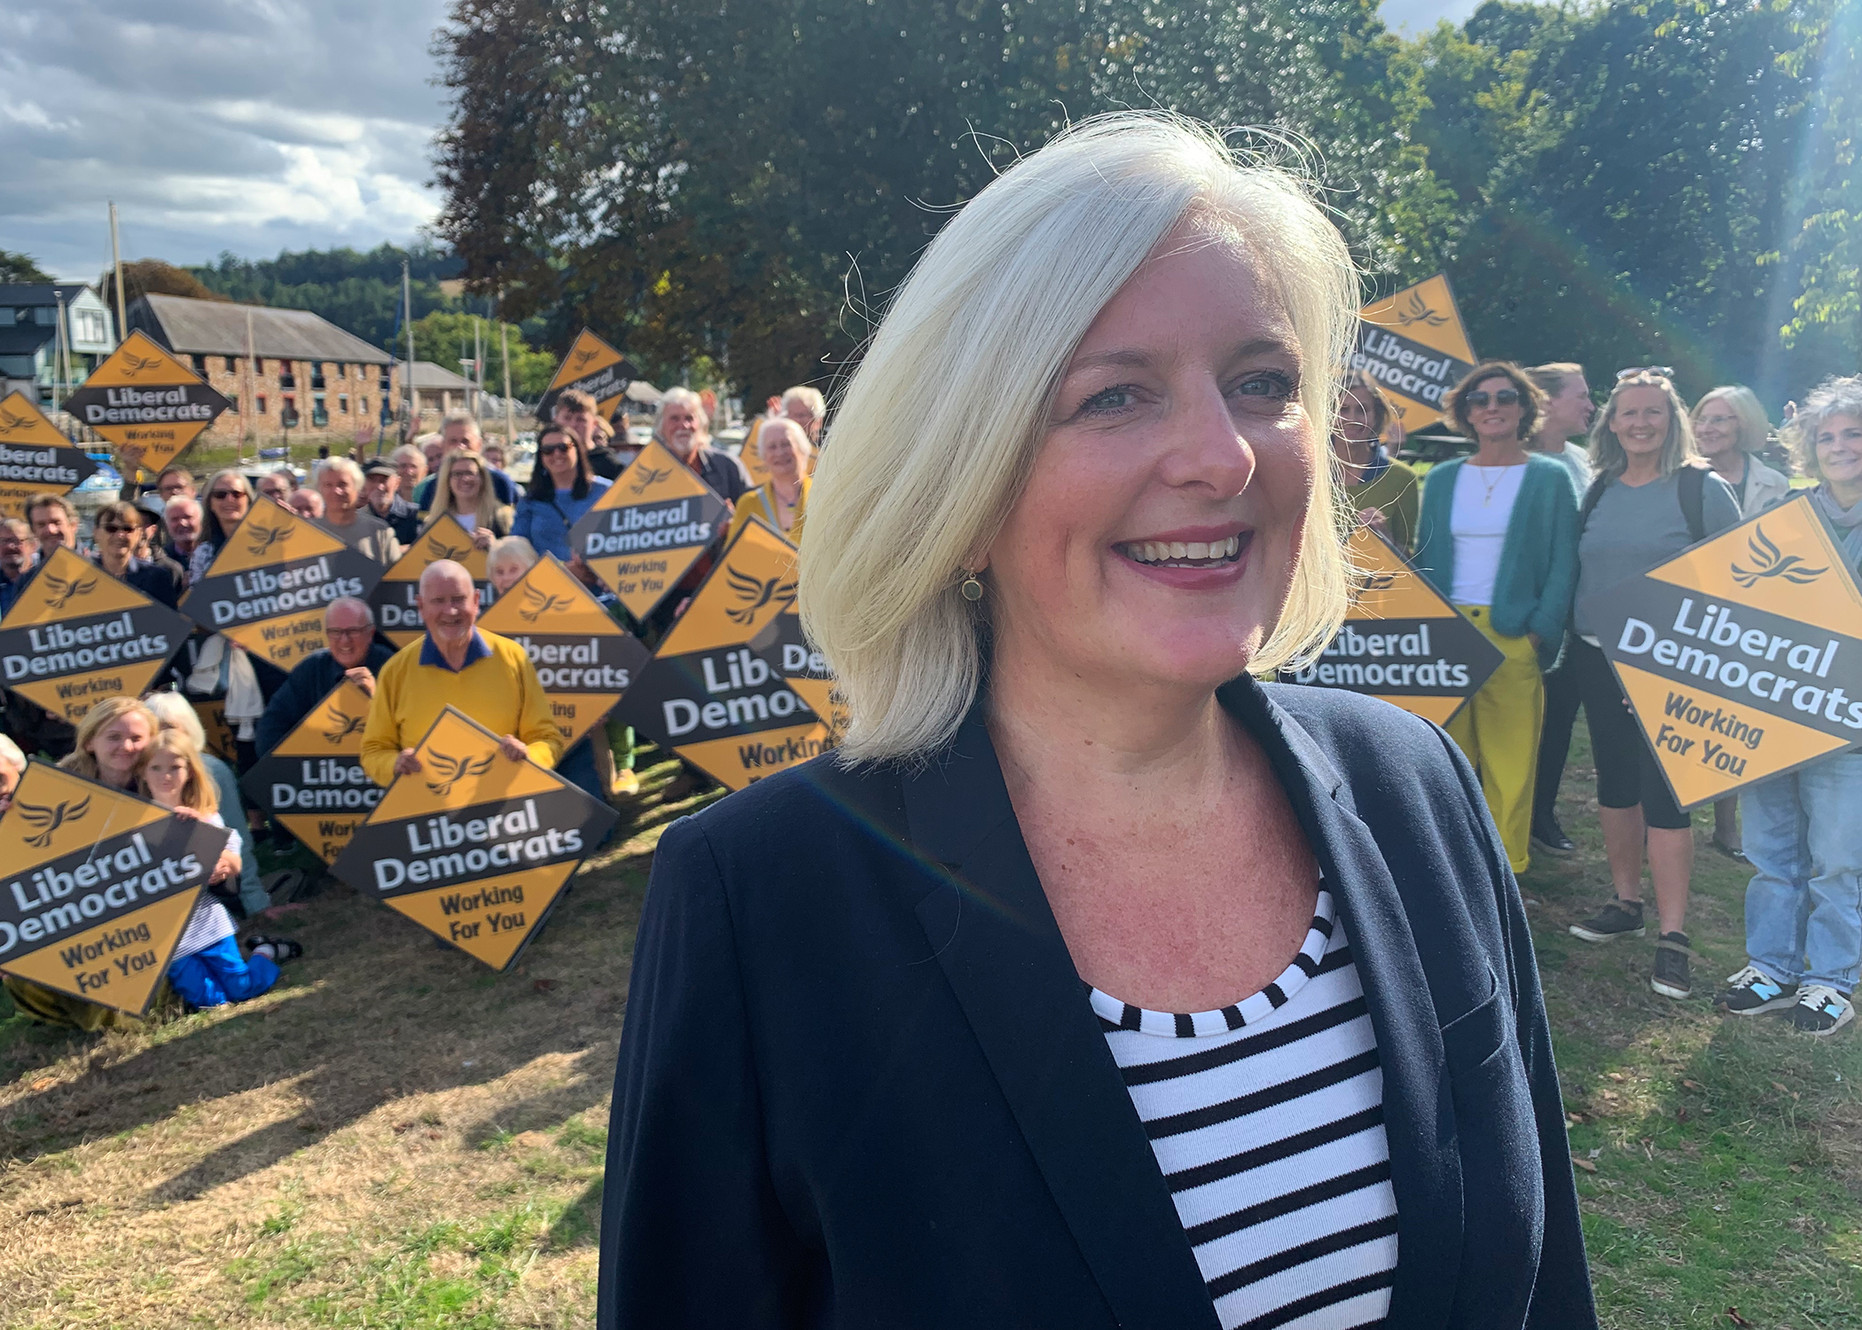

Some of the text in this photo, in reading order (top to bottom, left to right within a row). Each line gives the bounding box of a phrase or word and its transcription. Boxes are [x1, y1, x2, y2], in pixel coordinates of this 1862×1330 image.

[1364, 328, 1453, 381] Liberal
[85, 402, 213, 423] Democrats
[107, 385, 188, 407] Liberal
[0, 444, 57, 466] beral
[611, 500, 689, 534] Liberal
[586, 520, 711, 556] Democrats
[234, 556, 331, 598] Liberal
[617, 558, 667, 579] Working
[617, 578, 664, 595] For You
[211, 576, 364, 625] Democrats
[28, 611, 136, 653] Liberal
[261, 617, 322, 641] Working
[1673, 597, 1840, 679] Liberal
[2, 633, 170, 680] Democrats
[516, 637, 599, 664] beral
[56, 676, 123, 699] Working
[537, 665, 630, 688] ocrats
[1617, 617, 1862, 730] Democrats
[1664, 690, 1765, 750] Working
[1655, 723, 1748, 778] For You
[302, 759, 373, 786] Libe
[272, 783, 385, 808] Democ
[406, 798, 540, 854] Liberal
[9, 832, 153, 913] Liberal
[373, 826, 583, 891] Democrats
[439, 884, 525, 917] Working
[450, 910, 526, 942] For You
[60, 922, 151, 969] Working
[76, 949, 157, 994] For You
